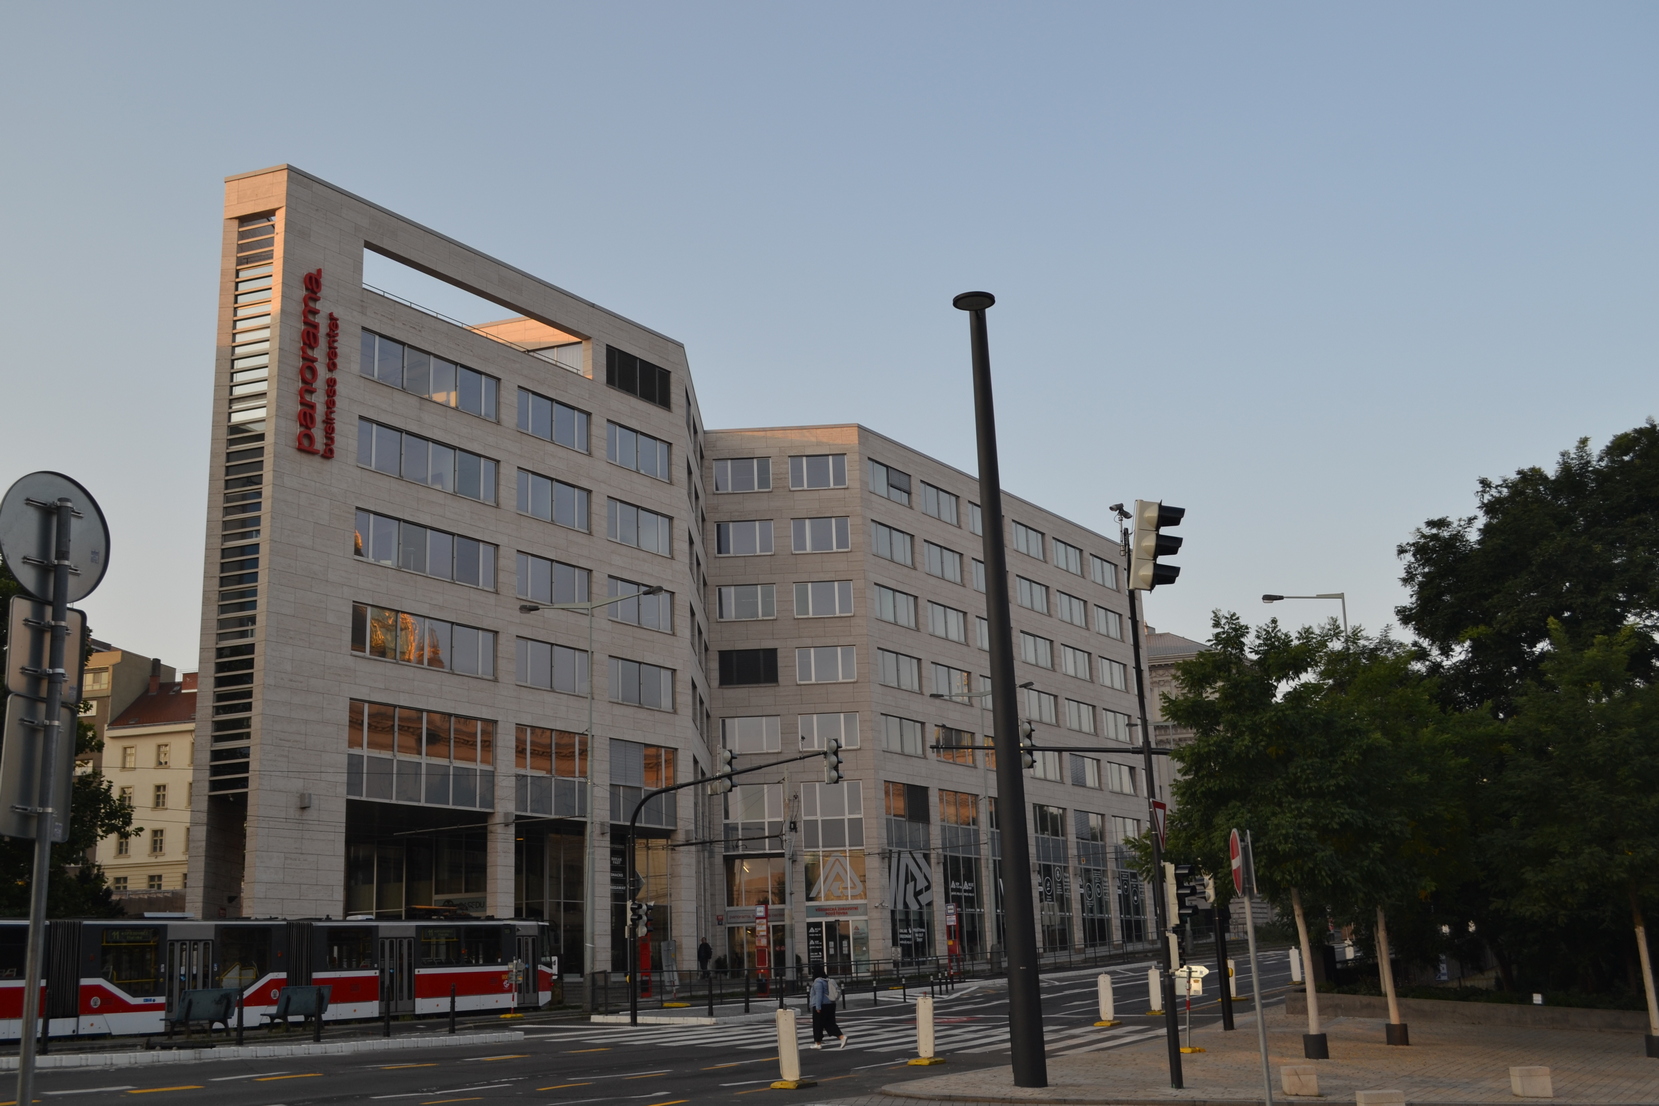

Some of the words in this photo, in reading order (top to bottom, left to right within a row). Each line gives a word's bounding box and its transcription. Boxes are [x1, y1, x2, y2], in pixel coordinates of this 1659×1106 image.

[297, 268, 322, 454] panorama
[327, 312, 339, 372] center
[322, 377, 337, 458] business
